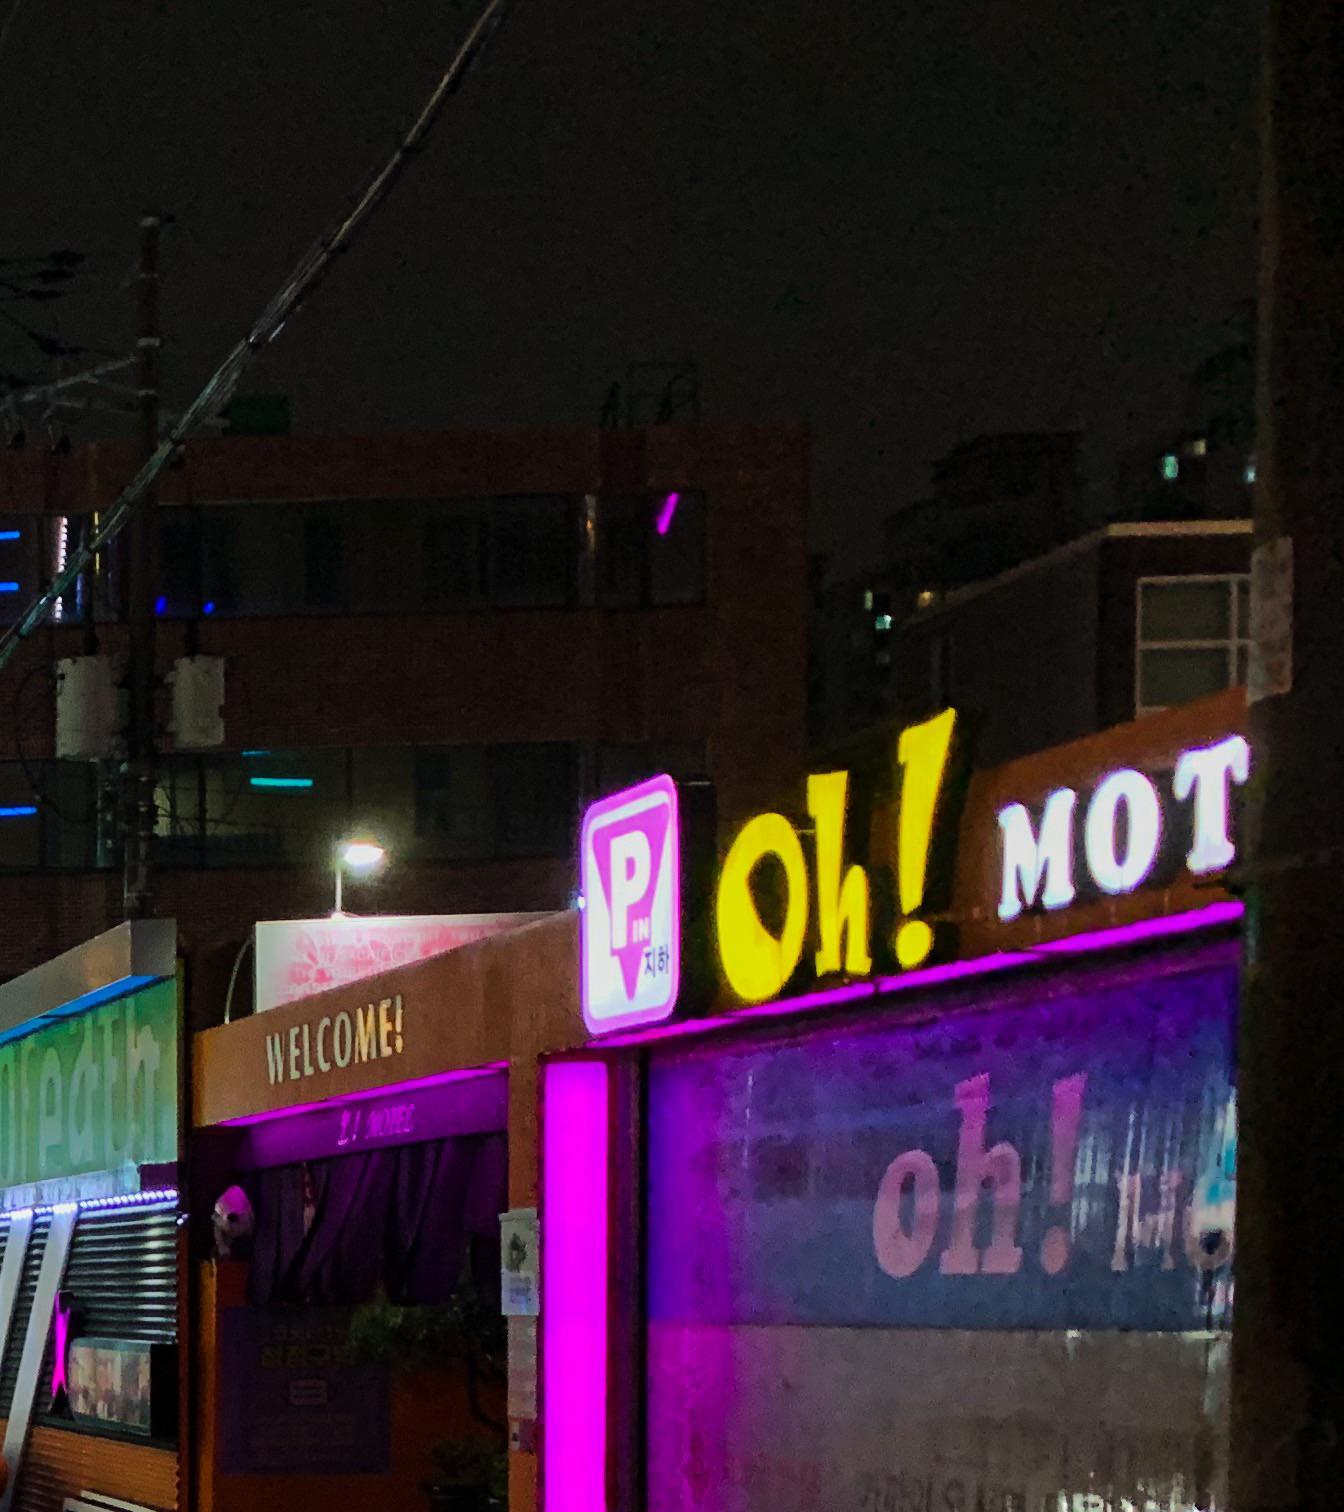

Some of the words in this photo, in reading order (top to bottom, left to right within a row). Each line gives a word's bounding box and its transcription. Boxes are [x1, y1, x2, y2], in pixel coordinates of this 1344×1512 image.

[610, 830, 652, 949] P
[717, 707, 957, 1001] Oh!
[632, 917, 649, 943] IN
[644, 943, 670, 978] 지하
[266, 995, 404, 1086] WELCOME!
